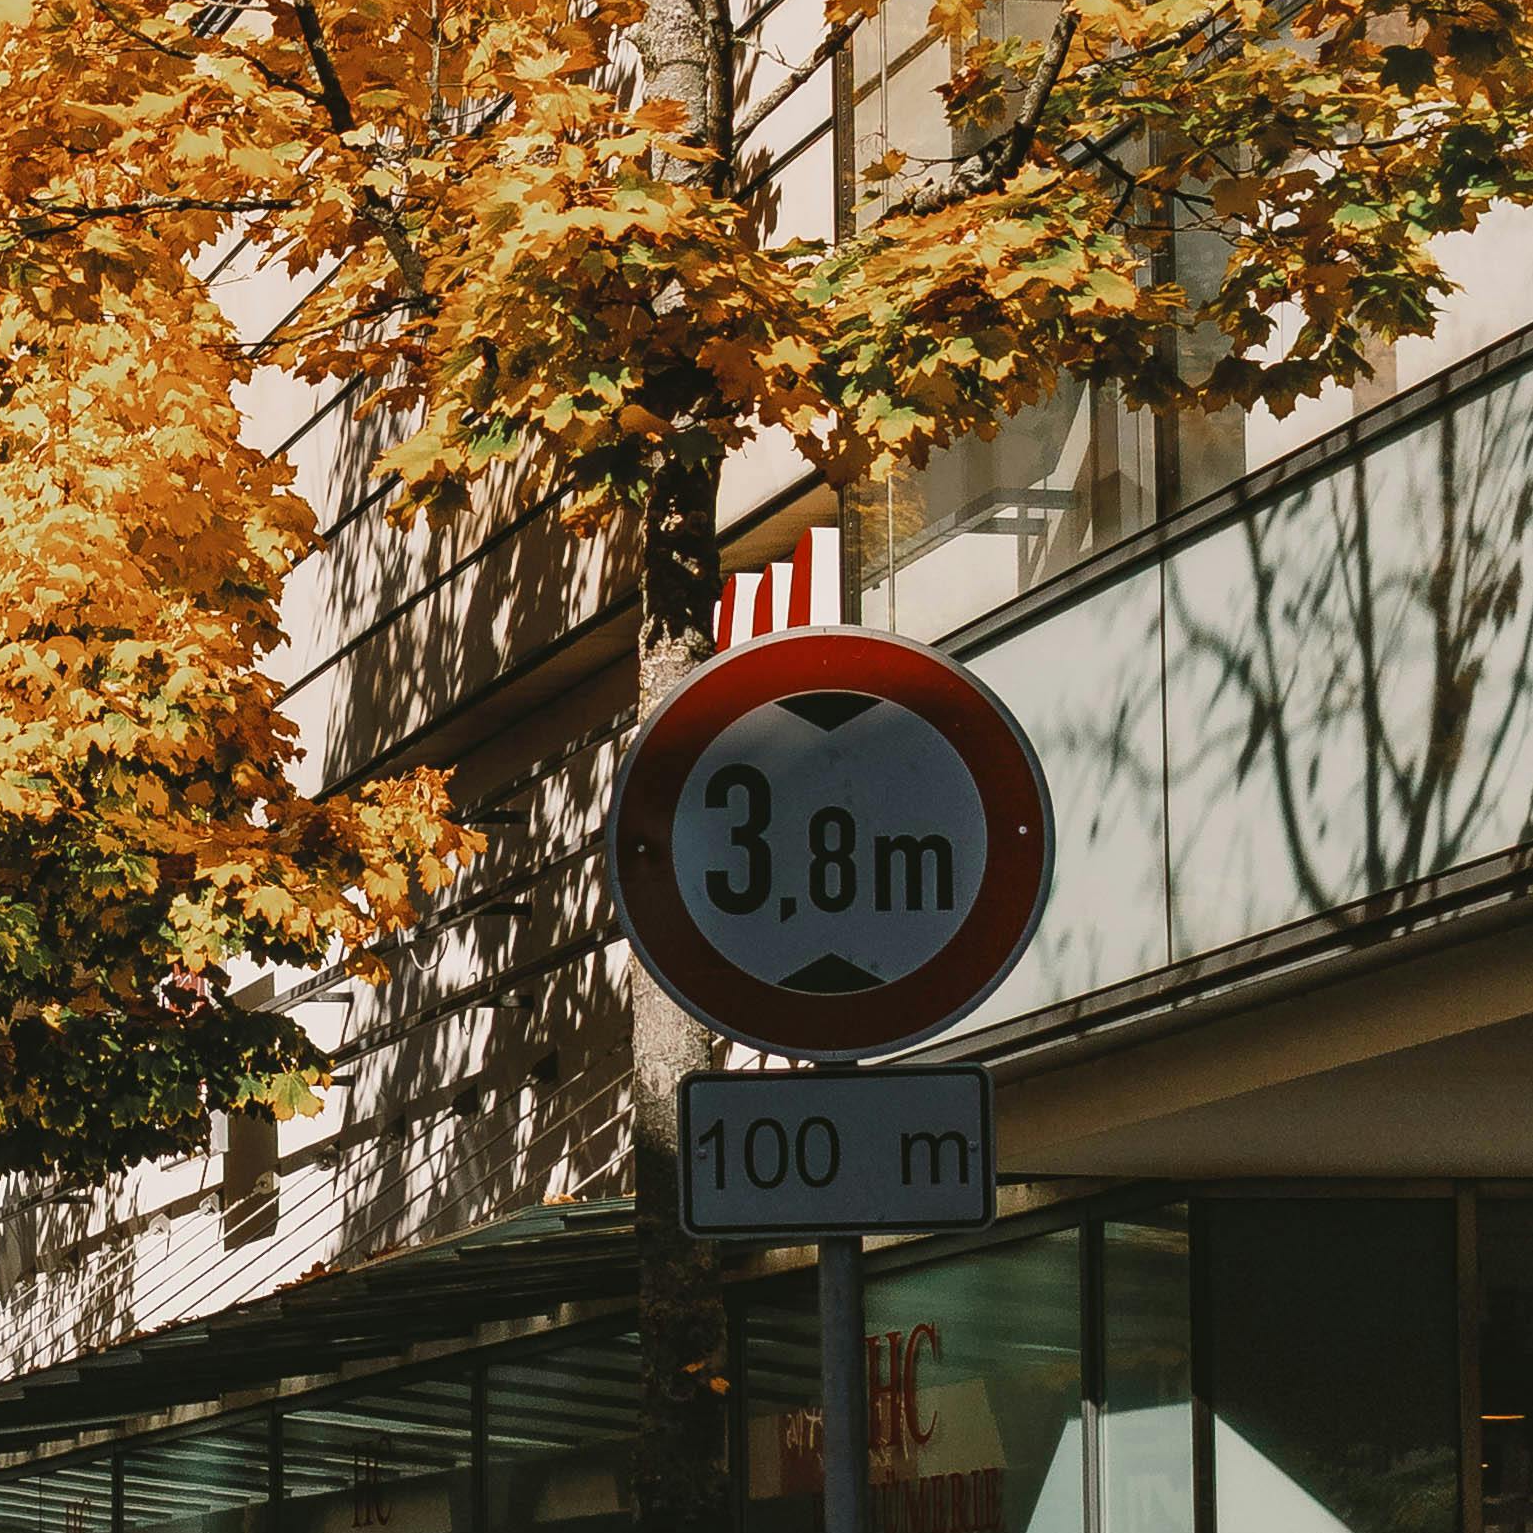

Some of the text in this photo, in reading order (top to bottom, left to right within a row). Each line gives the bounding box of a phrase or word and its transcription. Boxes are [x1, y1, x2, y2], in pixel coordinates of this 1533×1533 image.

[697, 1116, 970, 1191] 100 m
[864, 1321, 941, 1449] HC
